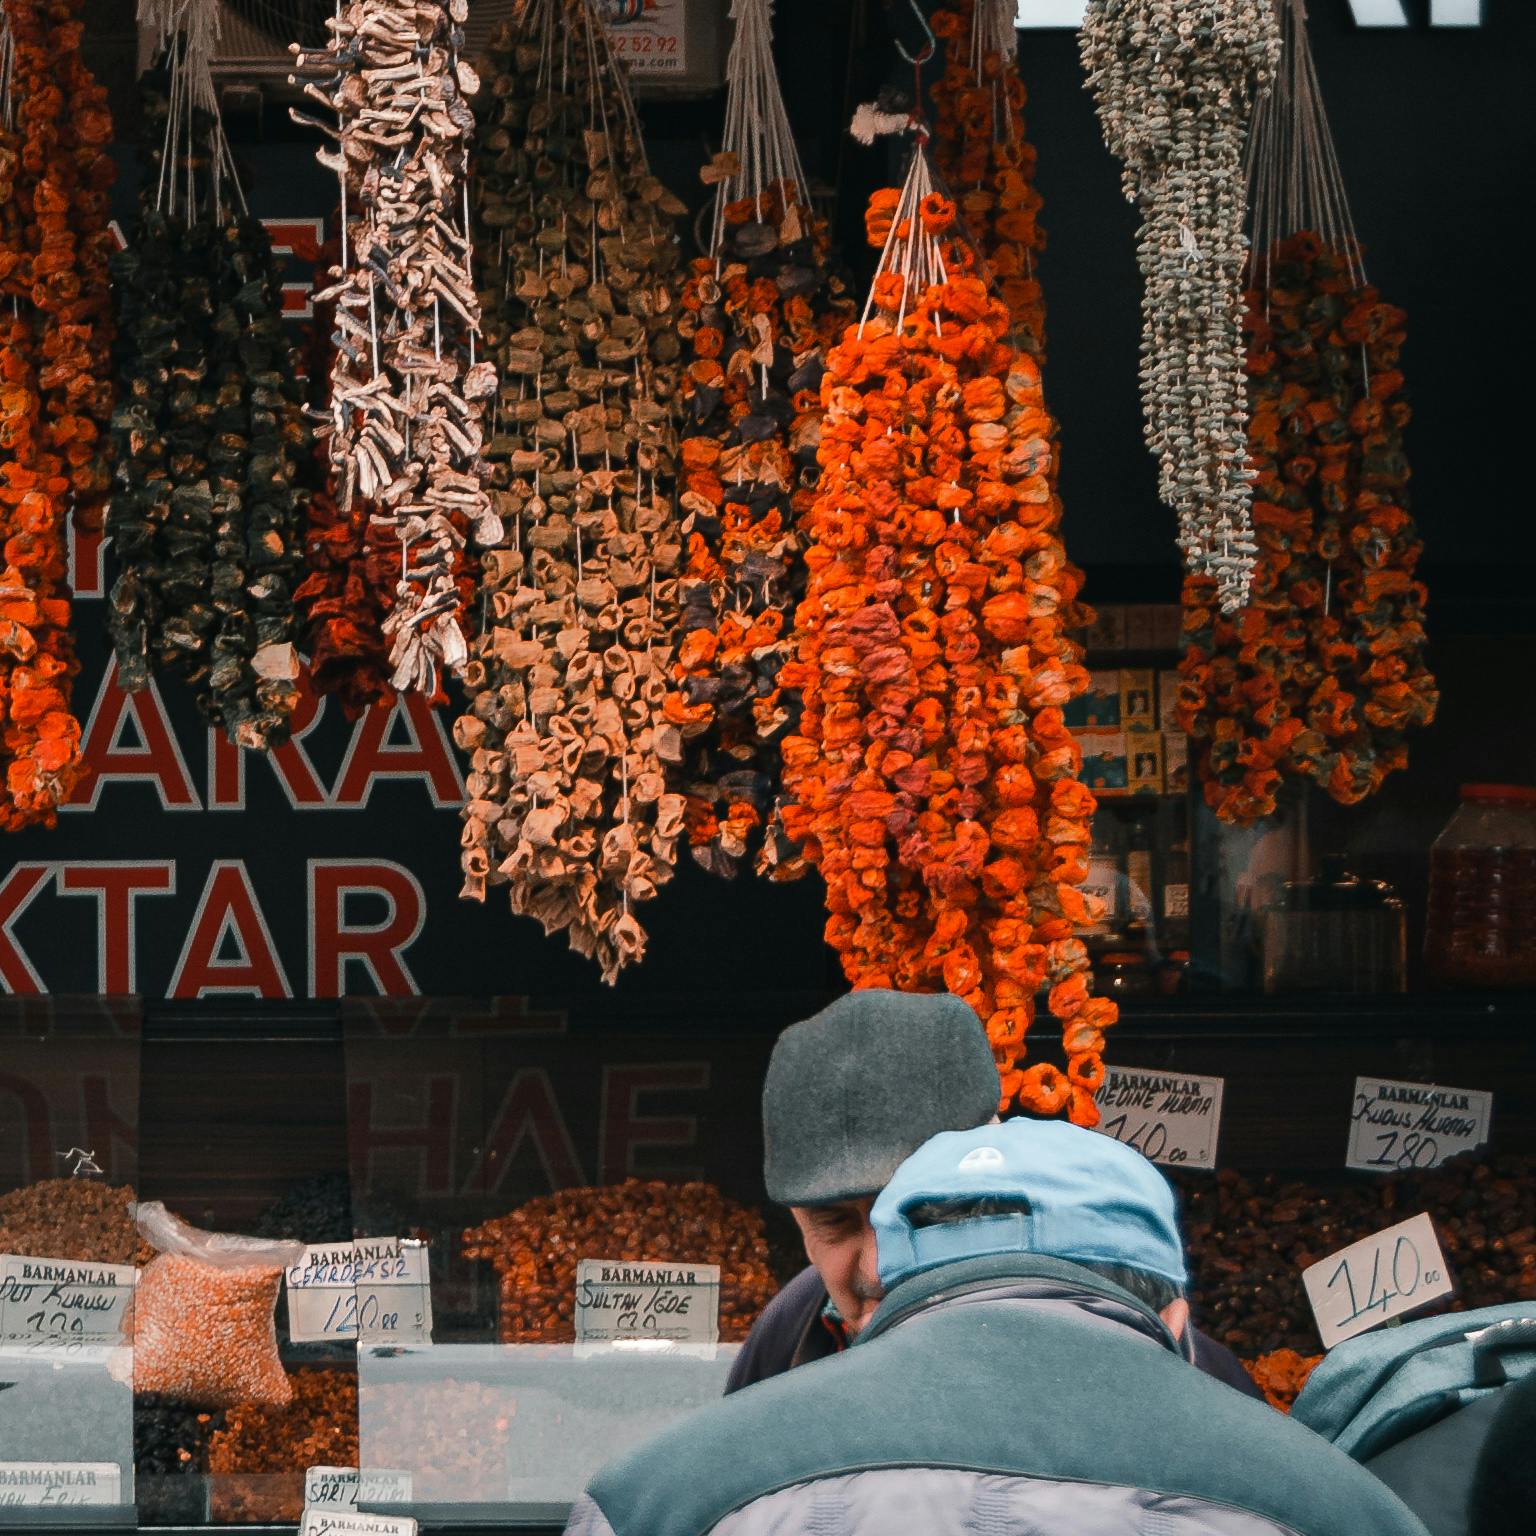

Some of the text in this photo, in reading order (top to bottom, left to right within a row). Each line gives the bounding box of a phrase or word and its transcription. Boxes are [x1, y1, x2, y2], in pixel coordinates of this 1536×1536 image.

[1109, 1073, 1201, 1096] BARMANLAR
[1378, 1086, 1470, 1110] BARMANLAR
[311, 1246, 404, 1266] BARMANLAR
[22, 1264, 116, 1286] BARMANLAR
[601, 1267, 697, 1285] BARMANLAR
[320, 1518, 400, 1535] BARMANLAR
